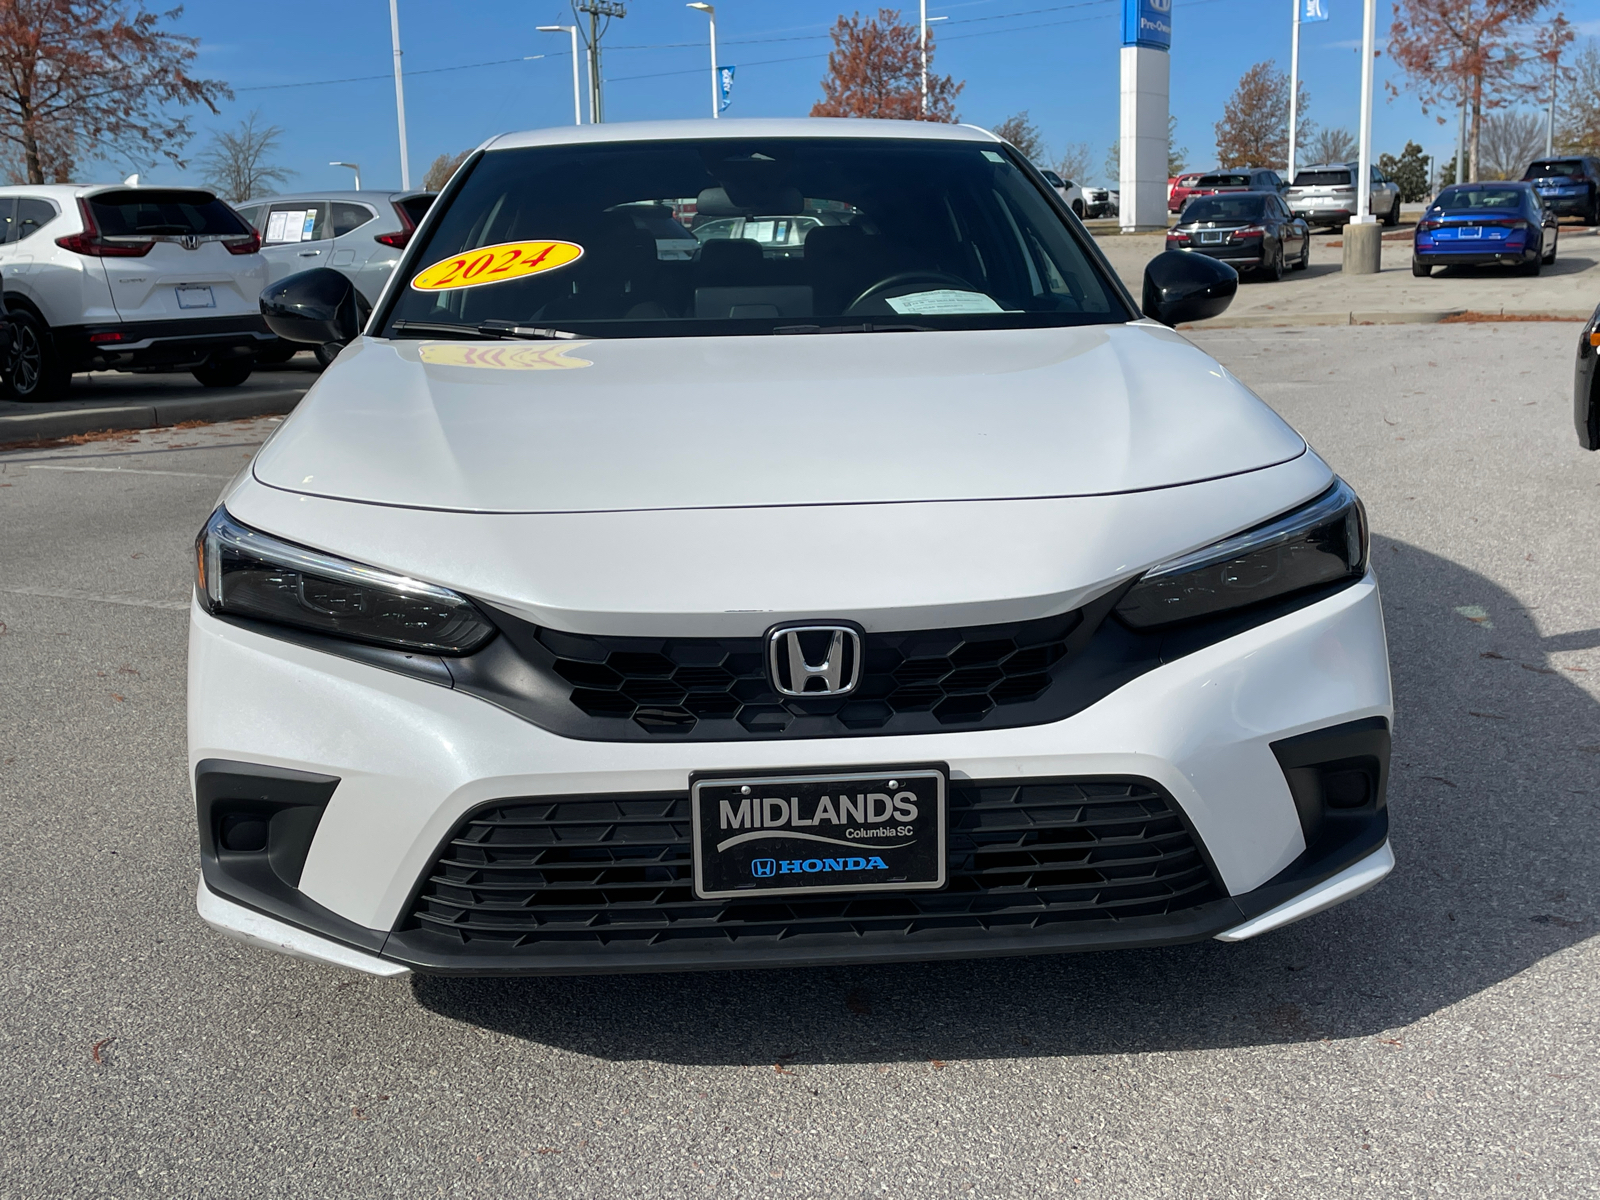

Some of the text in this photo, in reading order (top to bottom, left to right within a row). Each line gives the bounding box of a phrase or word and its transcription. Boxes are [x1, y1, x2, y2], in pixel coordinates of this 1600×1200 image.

[432, 244, 557, 287] 2024
[719, 791, 919, 829] MIDLANDS
[845, 825, 914, 839] Columbia SC
[779, 856, 889, 874] HONDA
